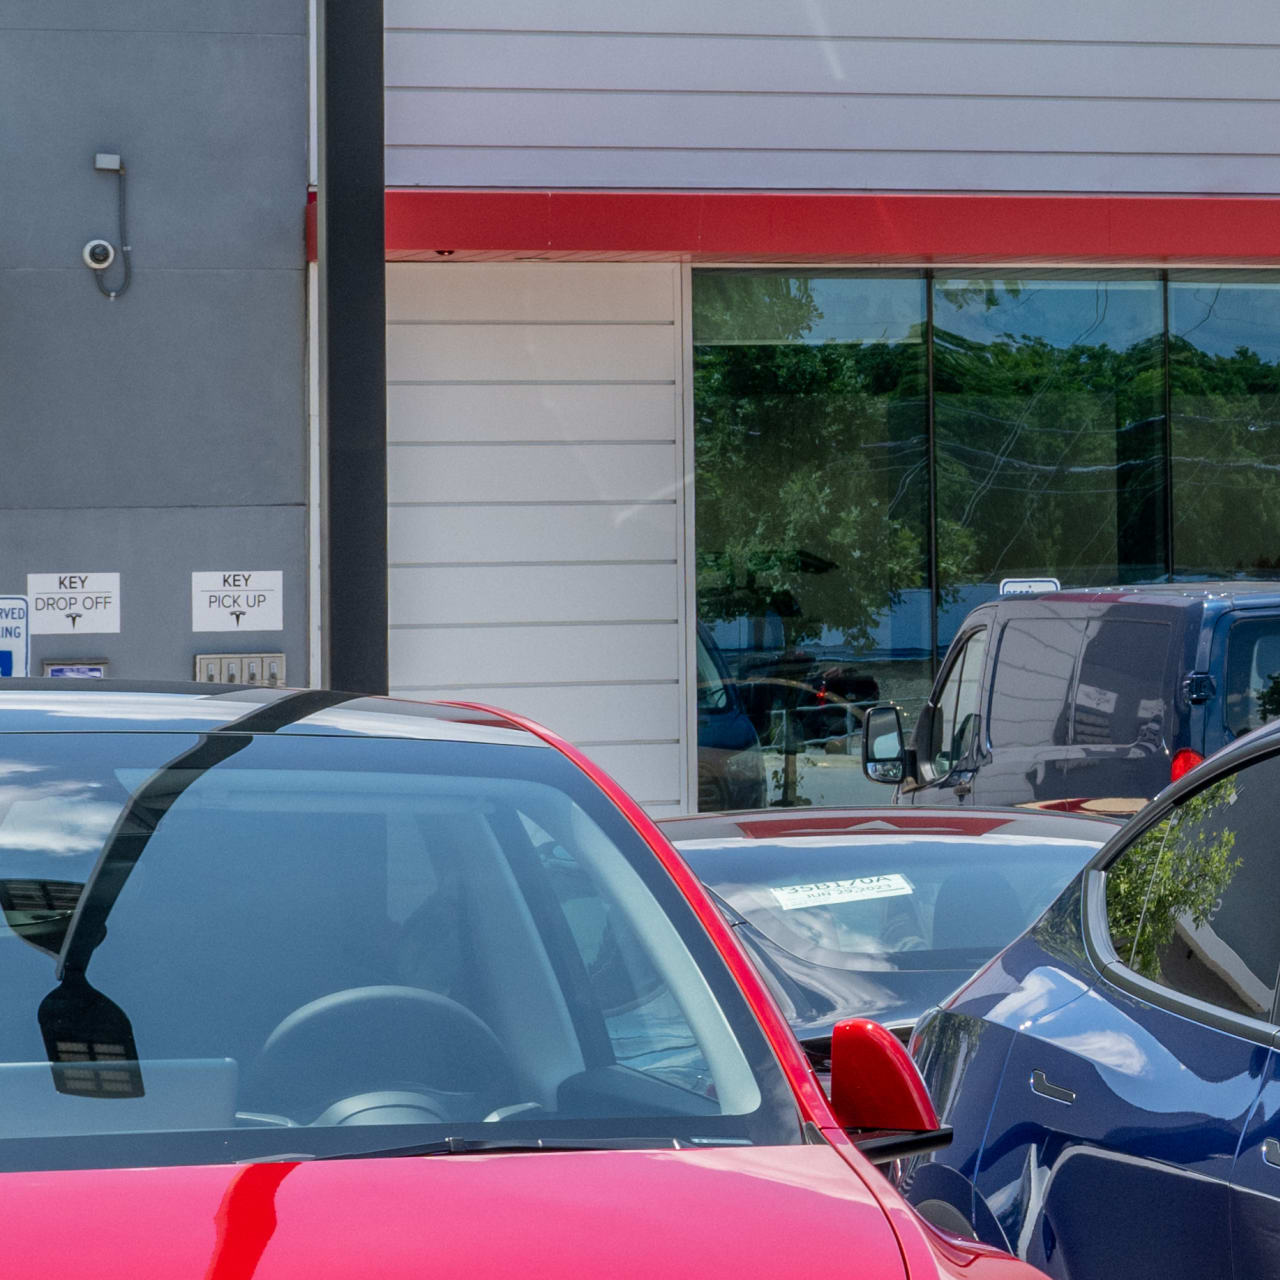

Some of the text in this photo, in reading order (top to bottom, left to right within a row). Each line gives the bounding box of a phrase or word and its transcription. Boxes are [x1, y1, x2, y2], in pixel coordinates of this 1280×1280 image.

[58, 576, 88, 590] KEY
[222, 574, 252, 588] KEY
[35, 596, 112, 611] DROP OFF
[208, 594, 266, 609] PICK UP
